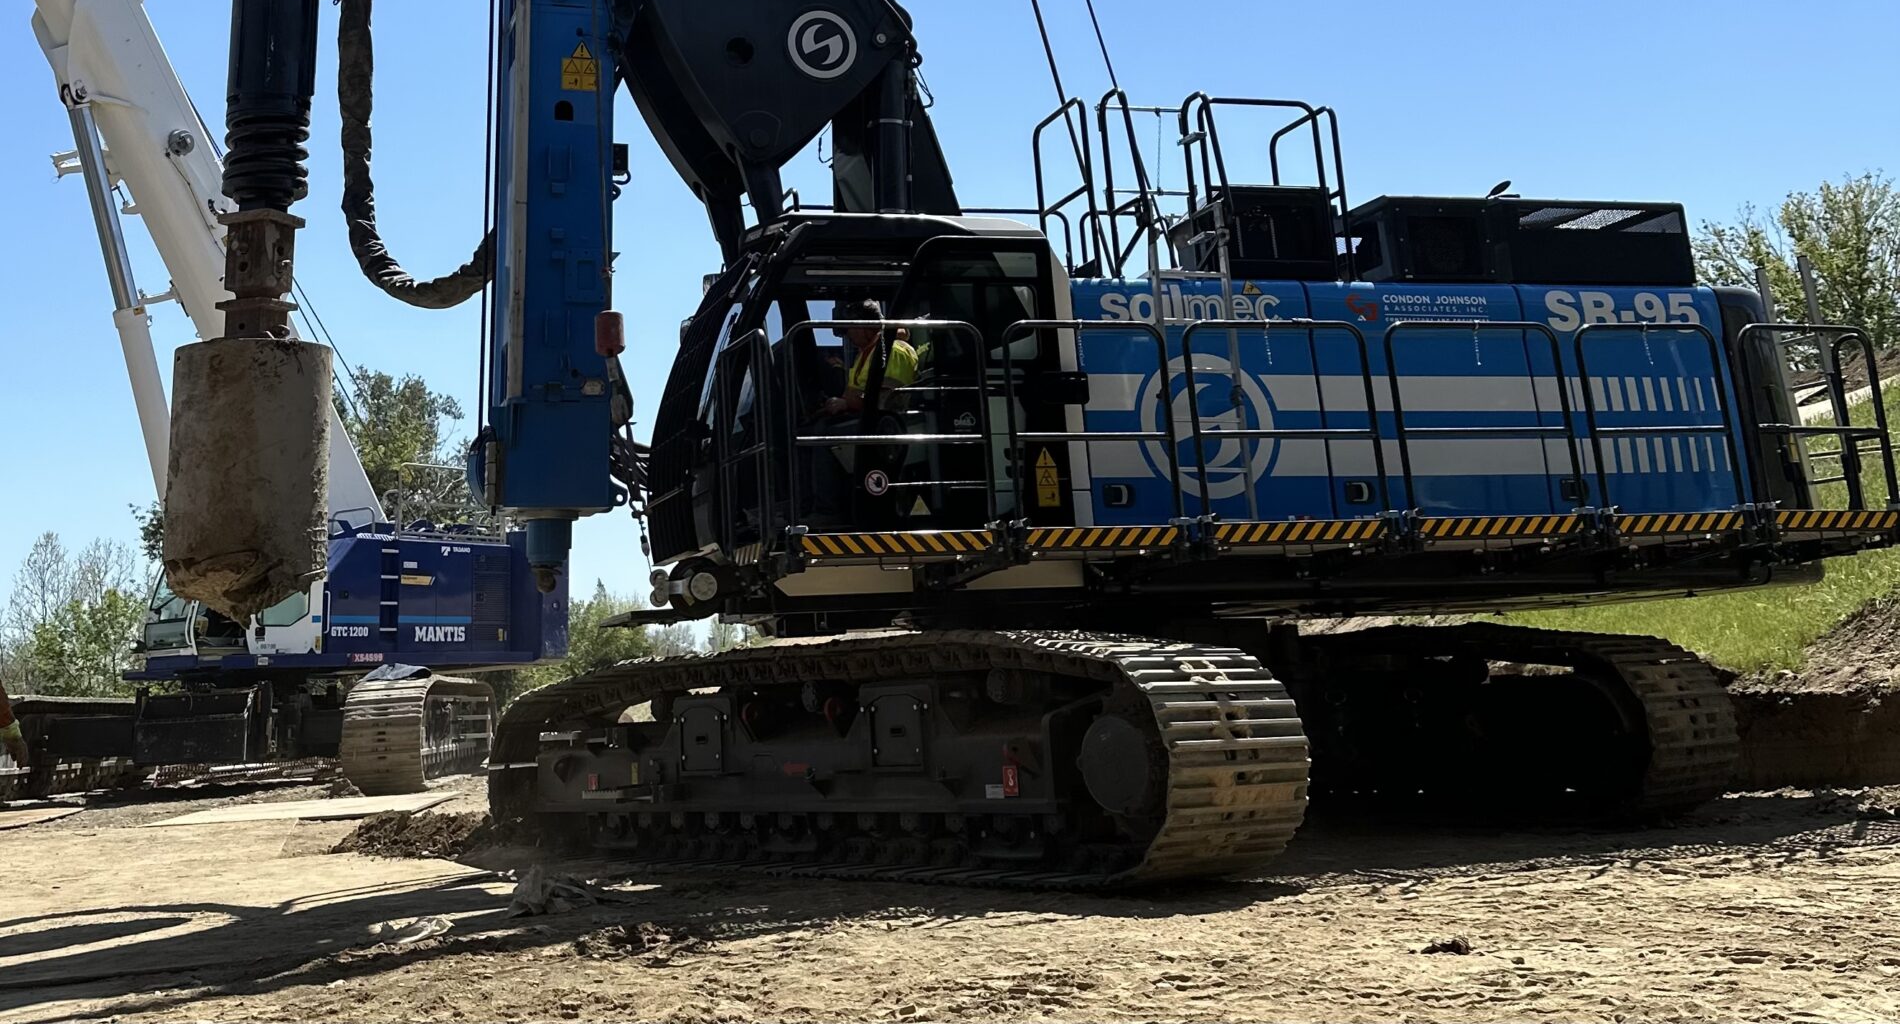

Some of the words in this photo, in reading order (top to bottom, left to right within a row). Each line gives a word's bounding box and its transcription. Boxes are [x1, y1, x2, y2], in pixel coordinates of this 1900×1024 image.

[1100, 284, 1281, 326] soilmec
[1382, 294, 1431, 304] CONDON
[1435, 295, 1487, 305] JOHNSON
[1467, 306, 1488, 314] INC.
[1544, 290, 1700, 333] SR-95
[331, 626, 369, 637] GTC-1200
[414, 626, 466, 642] MANTIS
